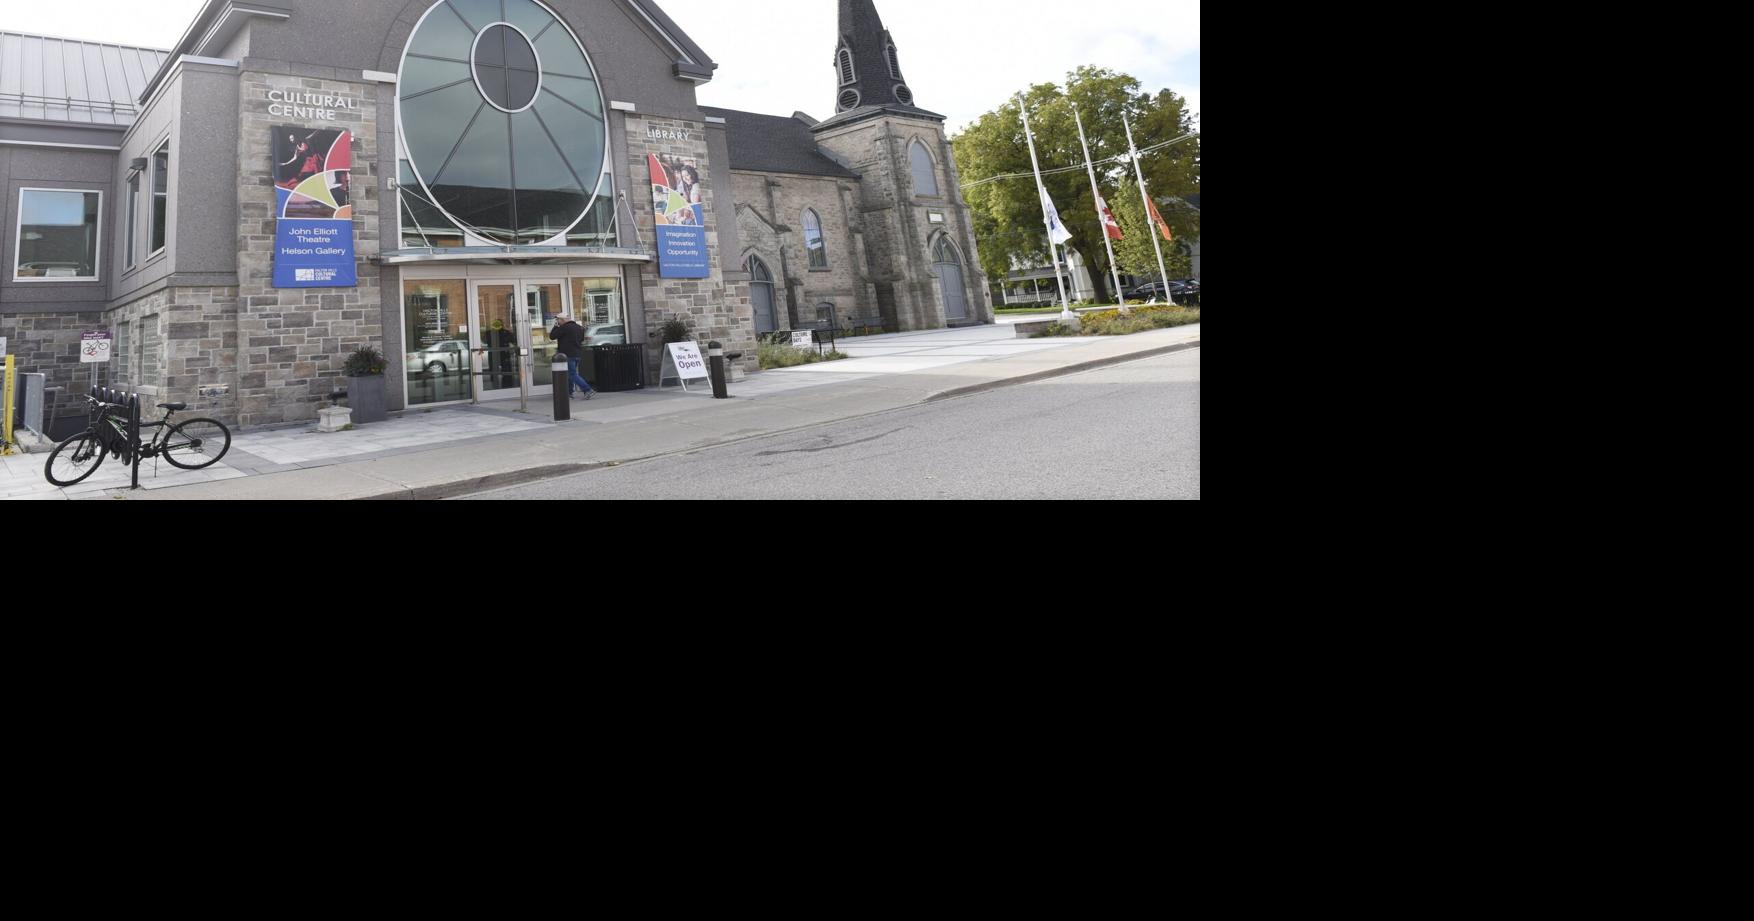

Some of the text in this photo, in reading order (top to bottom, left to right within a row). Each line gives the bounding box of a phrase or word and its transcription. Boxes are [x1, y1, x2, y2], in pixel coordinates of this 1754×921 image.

[268, 90, 356, 109] CULTURAL
[268, 103, 336, 120] CENTRE
[647, 128, 689, 141] LIBRARY
[297, 235, 331, 243] Theatre
[281, 247, 346, 256] Helson Gallery
[678, 360, 702, 369] Open
